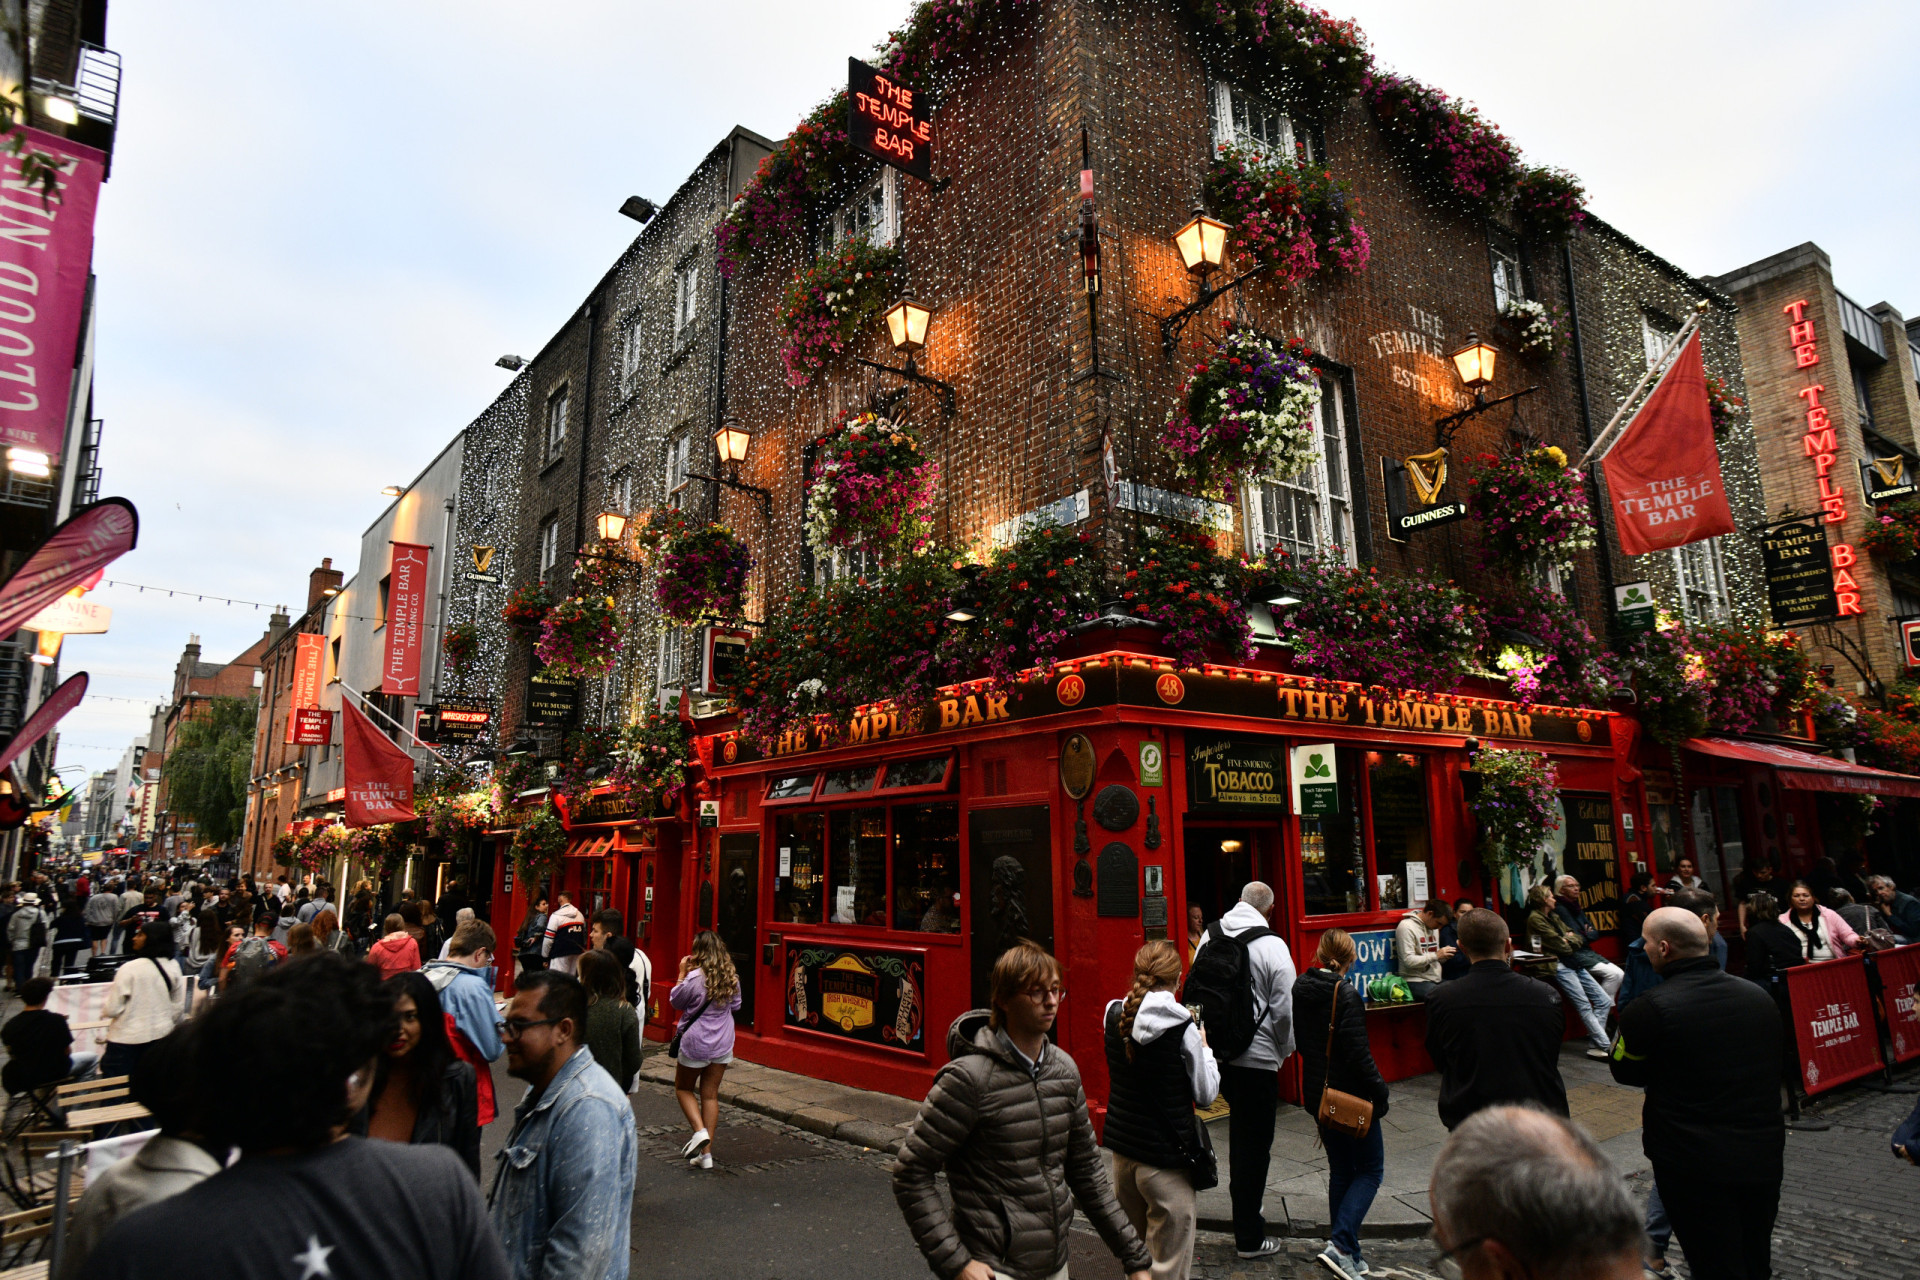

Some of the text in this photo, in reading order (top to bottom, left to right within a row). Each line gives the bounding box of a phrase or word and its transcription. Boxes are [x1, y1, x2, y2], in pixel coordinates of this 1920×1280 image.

[875, 75, 912, 109] THE
[856, 92, 930, 141] TEMPLE
[875, 128, 913, 159] BAR
[1407, 303, 1445, 339] THE
[0, 261, 39, 411] CLOUD
[1368, 331, 1445, 365] TEMPLE
[7, 427, 37, 443] NINE
[1783, 299, 1866, 616] THE TEMPLE BAR
[1647, 476, 1687, 494] THE
[1871, 485, 1912, 499] GUINNESS
[1079, 499, 1086, 512] 2
[1620, 480, 1714, 515] TEMPLE
[1401, 505, 1455, 528] GUINNESS
[1647, 504, 1696, 526] BAR
[1783, 528, 1802, 536] THE
[1764, 533, 1824, 550] TEMPLE
[1779, 547, 1812, 559] BAR
[466, 572, 497, 582] GUINNESS
[1771, 568, 1827, 582] BEER GARDEN
[1798, 594, 1828, 604] MUSIC
[1789, 603, 1817, 613] DAILY
[391, 564, 411, 674] THE TEMPLE BAR
[408, 608, 418, 648] TRADING
[303, 650, 318, 709] THE TEMPLE
[1161, 678, 1179, 697] 48
[1061, 680, 1079, 701] 48
[442, 711, 488, 722] WHISKEY SHOP
[453, 704, 477, 712] TEMPLE
[940, 690, 1010, 729] BAR
[1279, 687, 1534, 738] THE TEMPLE BAR
[725, 745, 736, 761] 48
[1191, 740, 1231, 762] Importers
[1227, 759, 1272, 769] FINE SMOKING
[366, 781, 390, 790] THE
[350, 790, 408, 801] TEMPLE
[1219, 793, 1246, 803] Always
[1259, 793, 1280, 802] Stock
[365, 800, 394, 810] BAR
[1594, 824, 1611, 841] THE
[1577, 842, 1614, 860] EMPEROR
[1605, 861, 1615, 879] OF
[568, 925, 582, 933] FILA
[827, 994, 868, 1009] IRISH WHISKEY
[1826, 1003, 1841, 1017] THE
[1895, 997, 1915, 1013] TEMP
[1811, 1012, 1859, 1038] TEMPLE BAR
